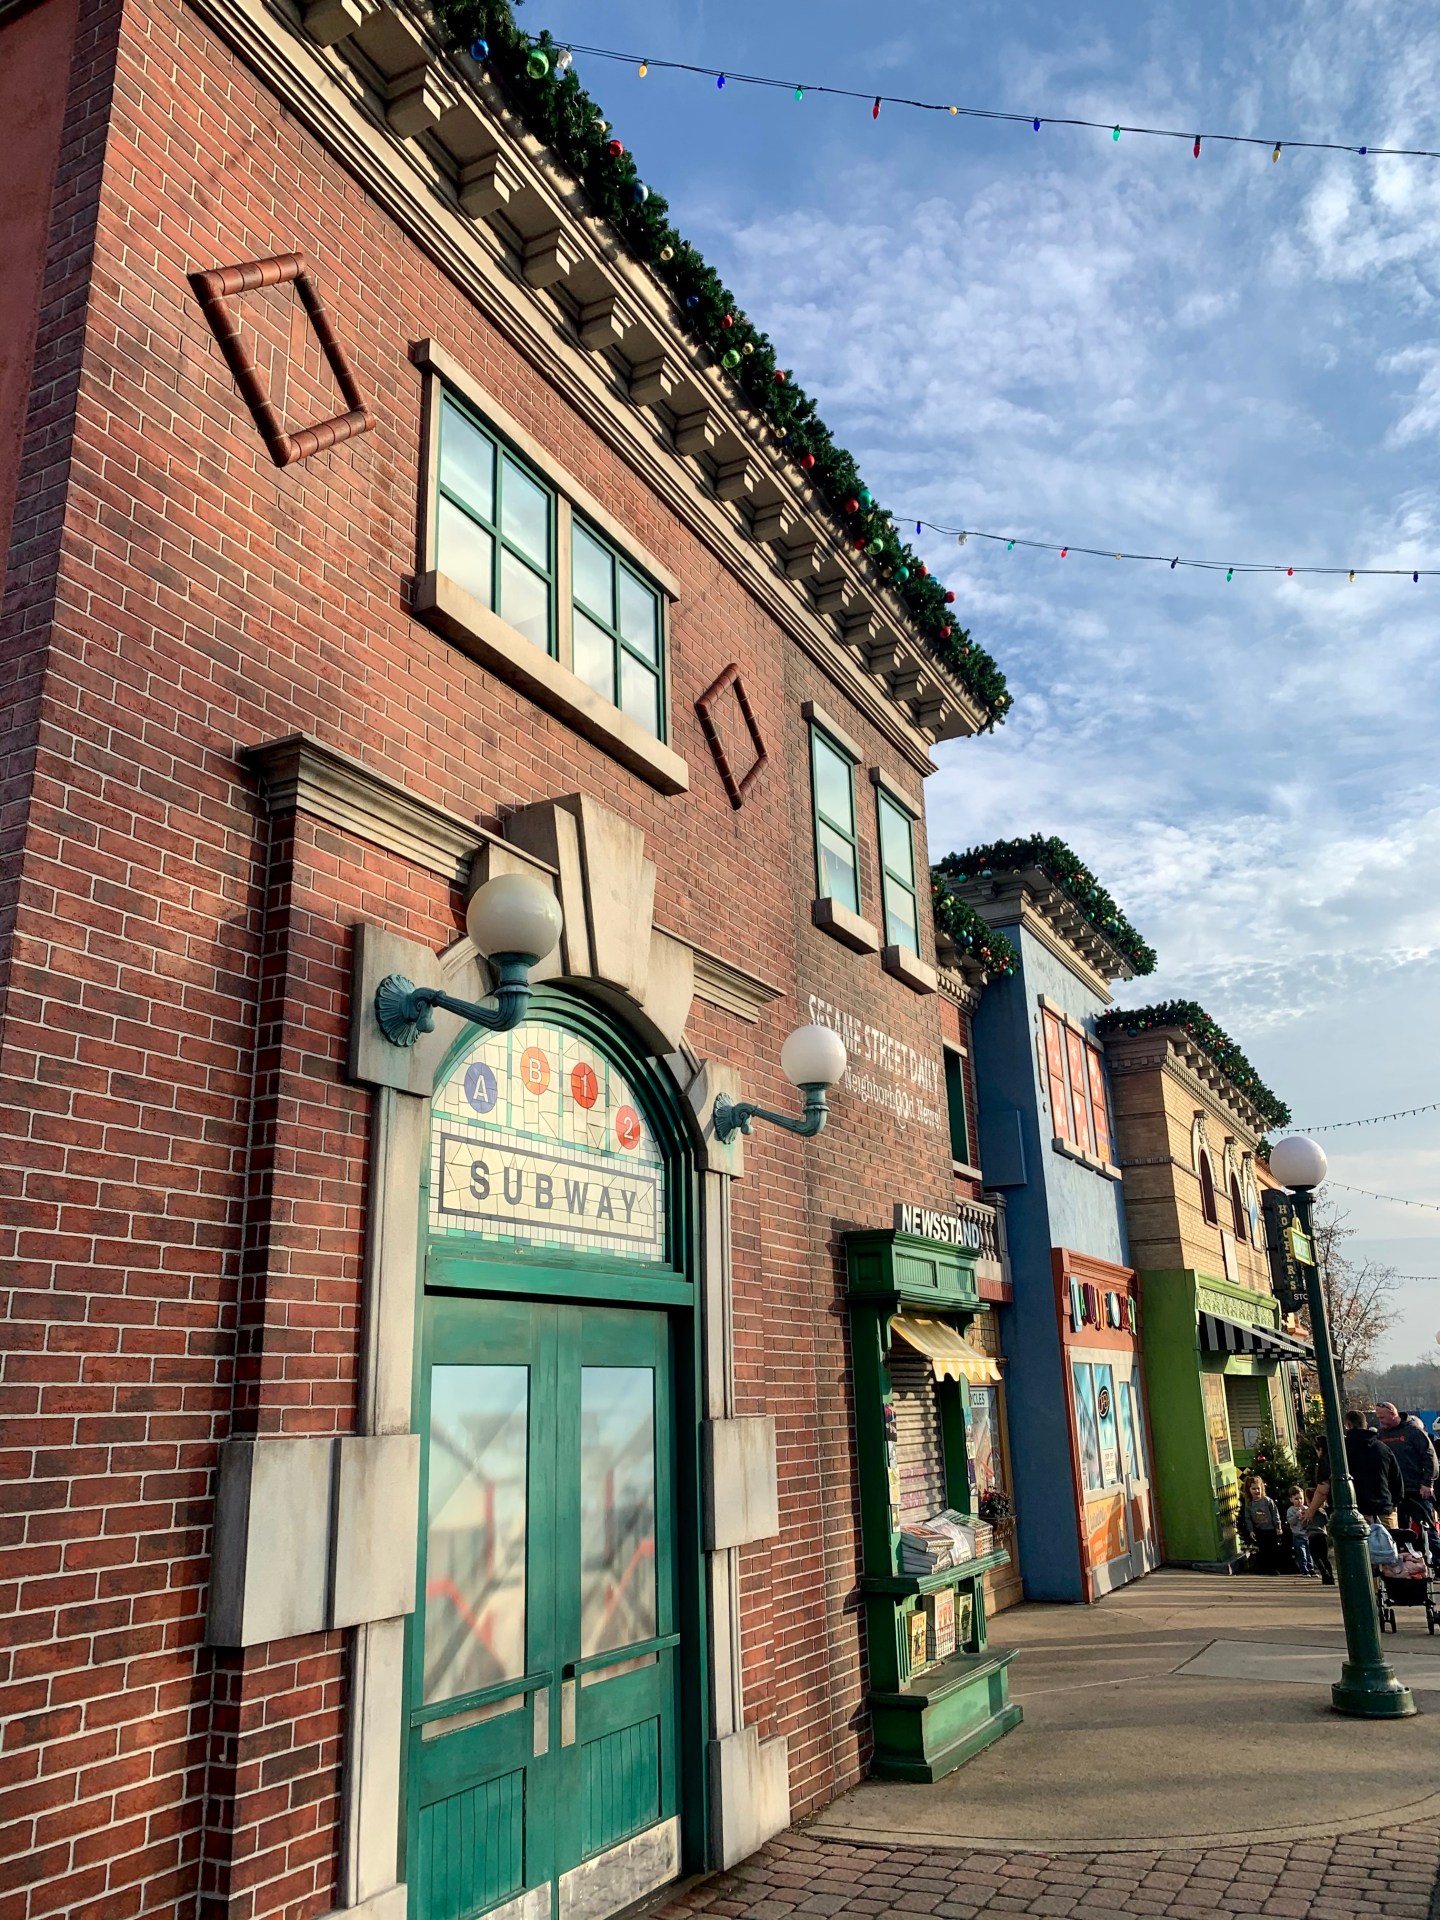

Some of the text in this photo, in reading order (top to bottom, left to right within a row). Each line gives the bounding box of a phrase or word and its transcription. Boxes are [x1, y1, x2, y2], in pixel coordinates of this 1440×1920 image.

[864, 1024, 908, 1079] STREET
[908, 1047, 939, 1097] DAILY
[472, 1058, 634, 1140] A B 1 2
[469, 1160, 637, 1223] SUBWAY
[901, 1203, 980, 1249] NEWSSTAND
